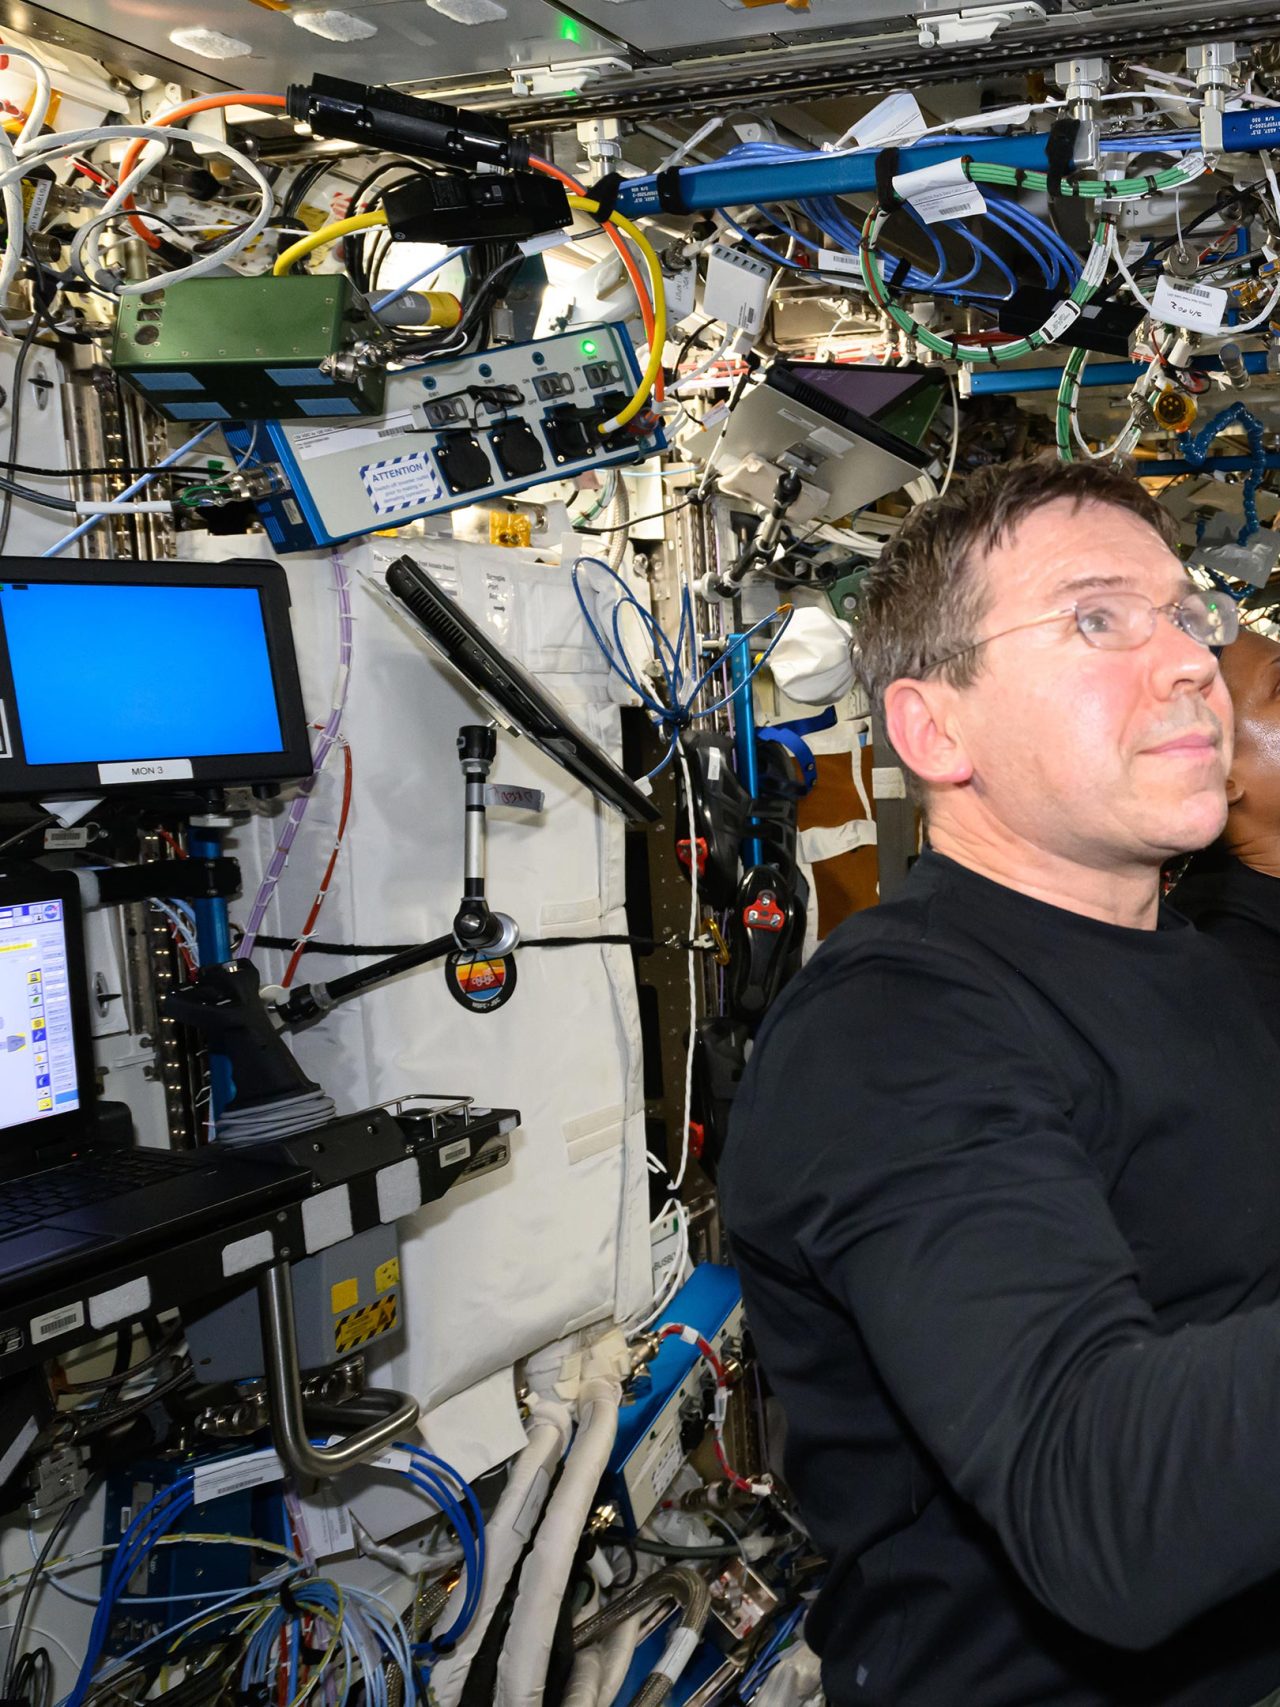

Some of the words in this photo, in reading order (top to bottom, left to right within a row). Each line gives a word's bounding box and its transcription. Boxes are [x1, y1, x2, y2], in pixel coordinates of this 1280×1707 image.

[372, 463, 423, 482] ATTENTION
[131, 767, 155, 776] MON
[157, 766, 164, 775] 3
